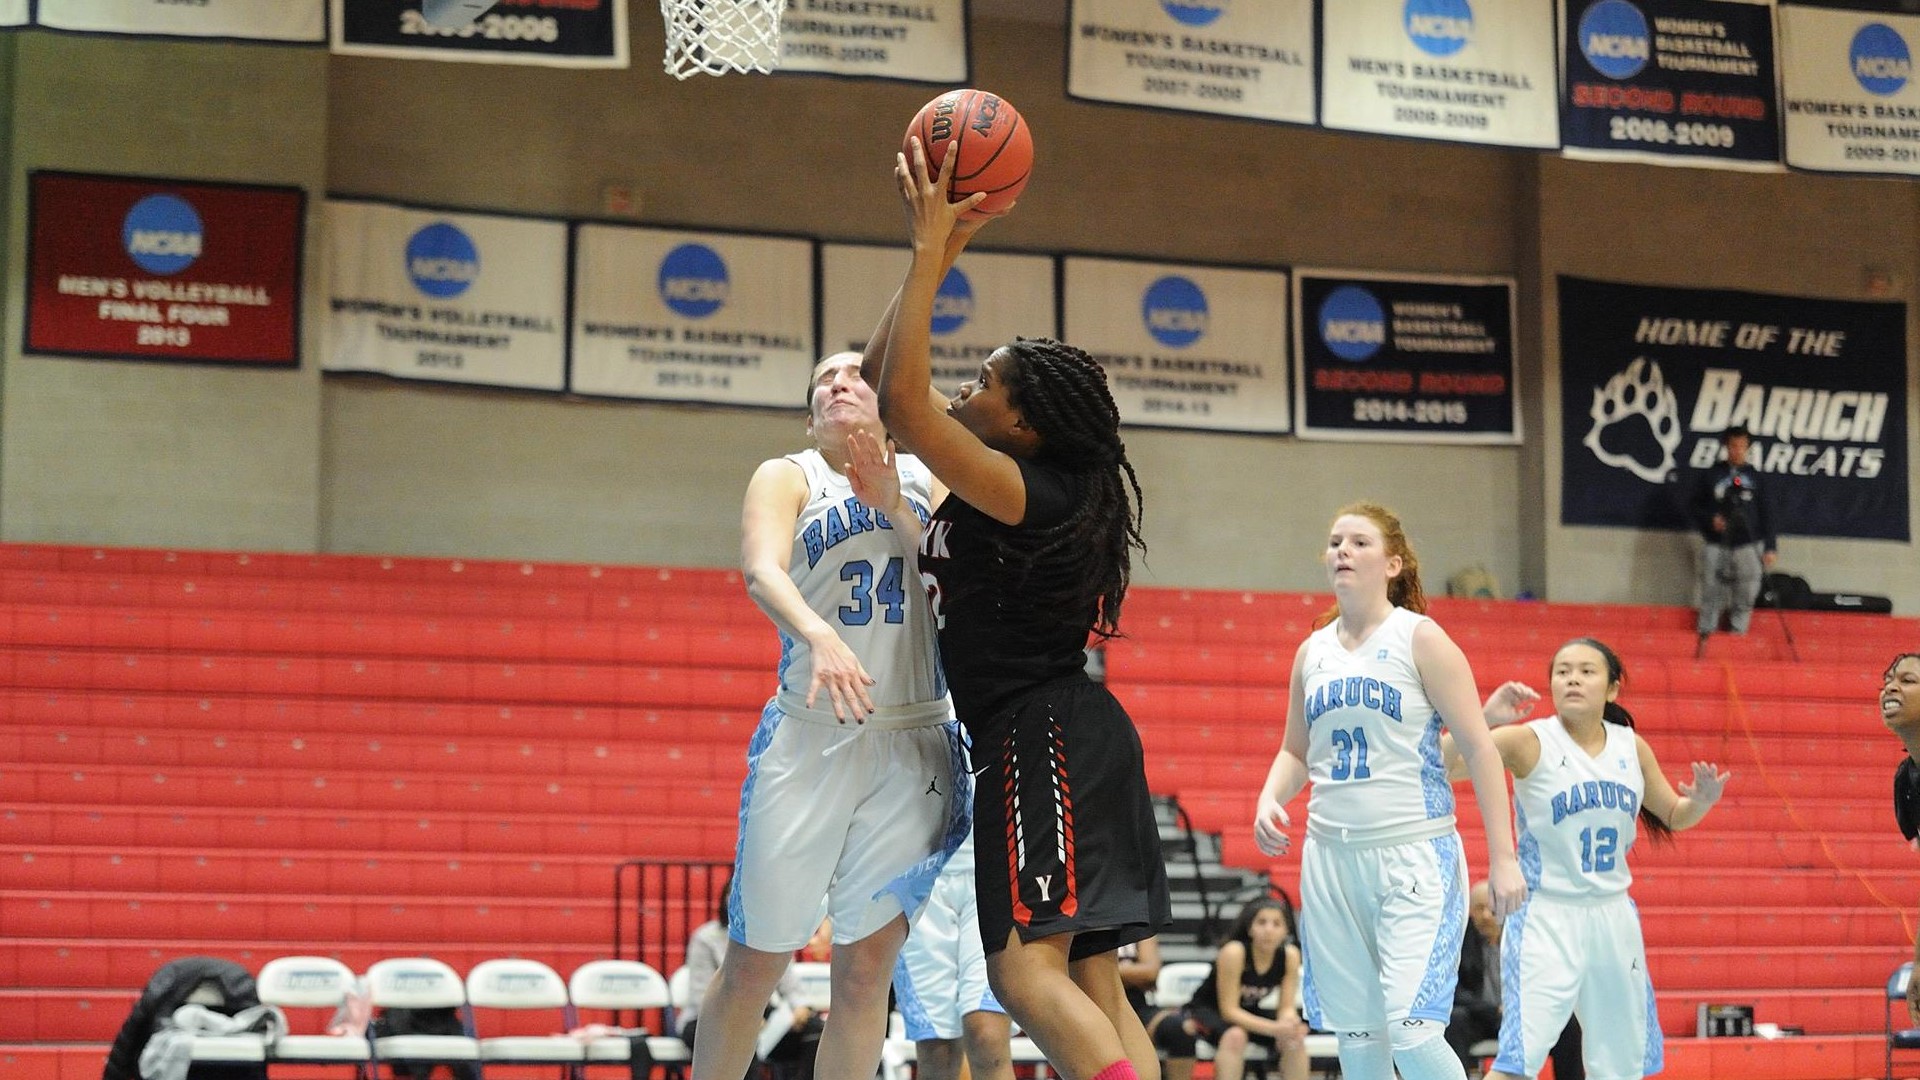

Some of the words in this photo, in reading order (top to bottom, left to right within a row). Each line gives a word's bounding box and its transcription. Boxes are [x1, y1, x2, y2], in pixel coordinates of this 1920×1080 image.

[400, 9, 559, 43] 2-2006
[780, 19, 907, 42] OURNAMENT
[1410, 15, 1474, 39] NCAA
[1654, 17, 1726, 38] WOMEN'S
[1080, 25, 1174, 49] WOMEN'S
[1181, 35, 1304, 66] BASKETBALL
[1588, 33, 1649, 60] NCAA
[1655, 35, 1751, 58] BASKETBALL
[1125, 53, 1261, 81] TOURNAMENT
[1349, 58, 1406, 78] MEN'S
[1412, 64, 1533, 91] BASKETBALL
[1657, 53, 1760, 76] TOURNAMENT
[1856, 56, 1912, 79] NCAA
[1377, 83, 1506, 108] TOURNAMENT
[1573, 83, 1675, 114] SECOND
[1680, 91, 1766, 120] ROUND
[1788, 100, 1868, 118] WOMEN'S
[1845, 147, 1920, 161] 2009-201
[131, 230, 203, 258] NCAA
[58, 275, 129, 299] MEN'S
[132, 280, 271, 306] VOLLEYBALL
[98, 300, 162, 323] FINAL
[167, 304, 230, 327] FOUR
[331, 298, 421, 320] WOMEN'S
[428, 308, 555, 333] VOLLEYBALL
[1392, 301, 1463, 319] WOMEN'S
[377, 323, 511, 350] TOURNAMENT
[584, 322, 675, 342] WOMEN'S
[682, 328, 803, 350] BASKETBALL
[1325, 320, 1387, 344] NCAA
[1392, 318, 1487, 336] BASKETBALL
[1635, 316, 1732, 348] HOME
[1734, 322, 1780, 351] OF
[1787, 327, 1846, 358] THE
[629, 346, 761, 369] TOURNAMENT
[1394, 336, 1496, 354] TOURNAMENT
[1150, 357, 1263, 379] BASKETBALL
[1315, 368, 1413, 392] SECOND
[1419, 373, 1505, 394] ROUND
[1115, 375, 1239, 396] TOURNAMENT
[1689, 367, 1890, 444] BARUCH
[1689, 437, 1886, 479] BARCATS
[839, 556, 905, 626] 34
[1331, 726, 1371, 781] 31
[1579, 827, 1618, 873] 12
[1035, 874, 1052, 902] Y
